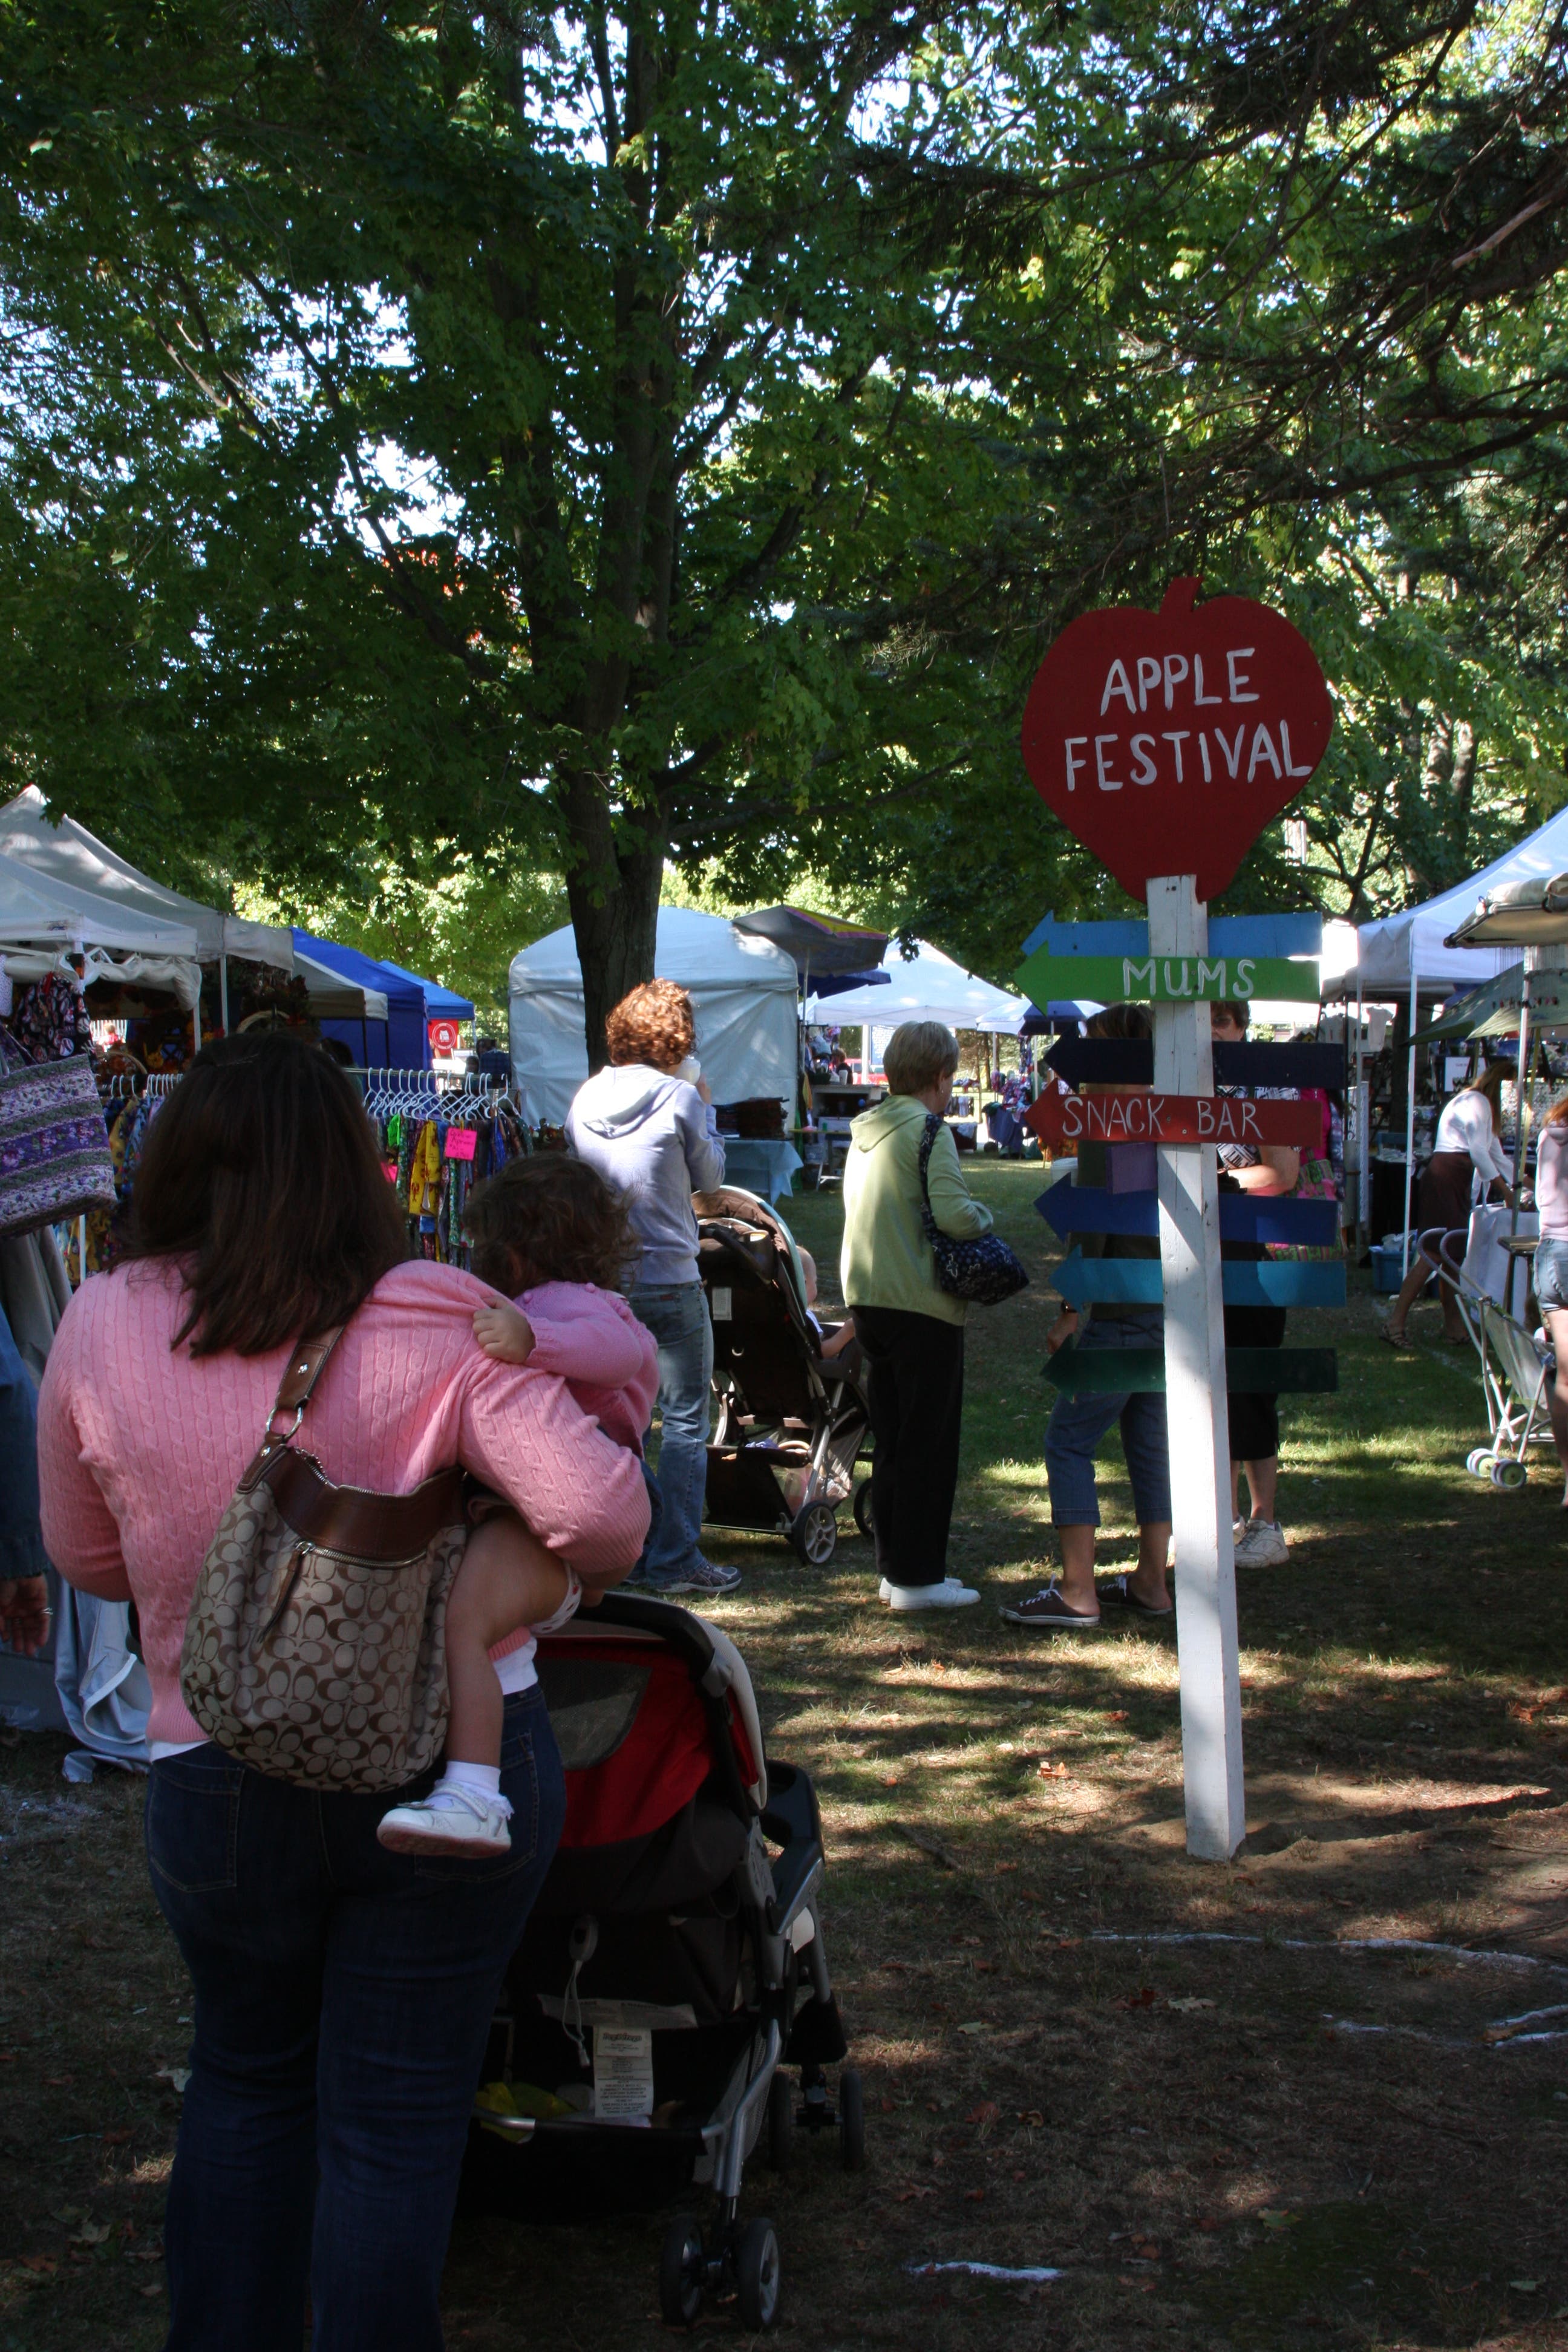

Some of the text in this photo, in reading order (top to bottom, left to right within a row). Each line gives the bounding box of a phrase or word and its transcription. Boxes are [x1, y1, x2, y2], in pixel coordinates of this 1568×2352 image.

[1100, 647, 1259, 716] APPLE
[1065, 719, 1313, 791] FESTIVAL
[1123, 958, 1256, 998] MUMS
[1062, 1096, 1264, 1140] SNACK BAR
